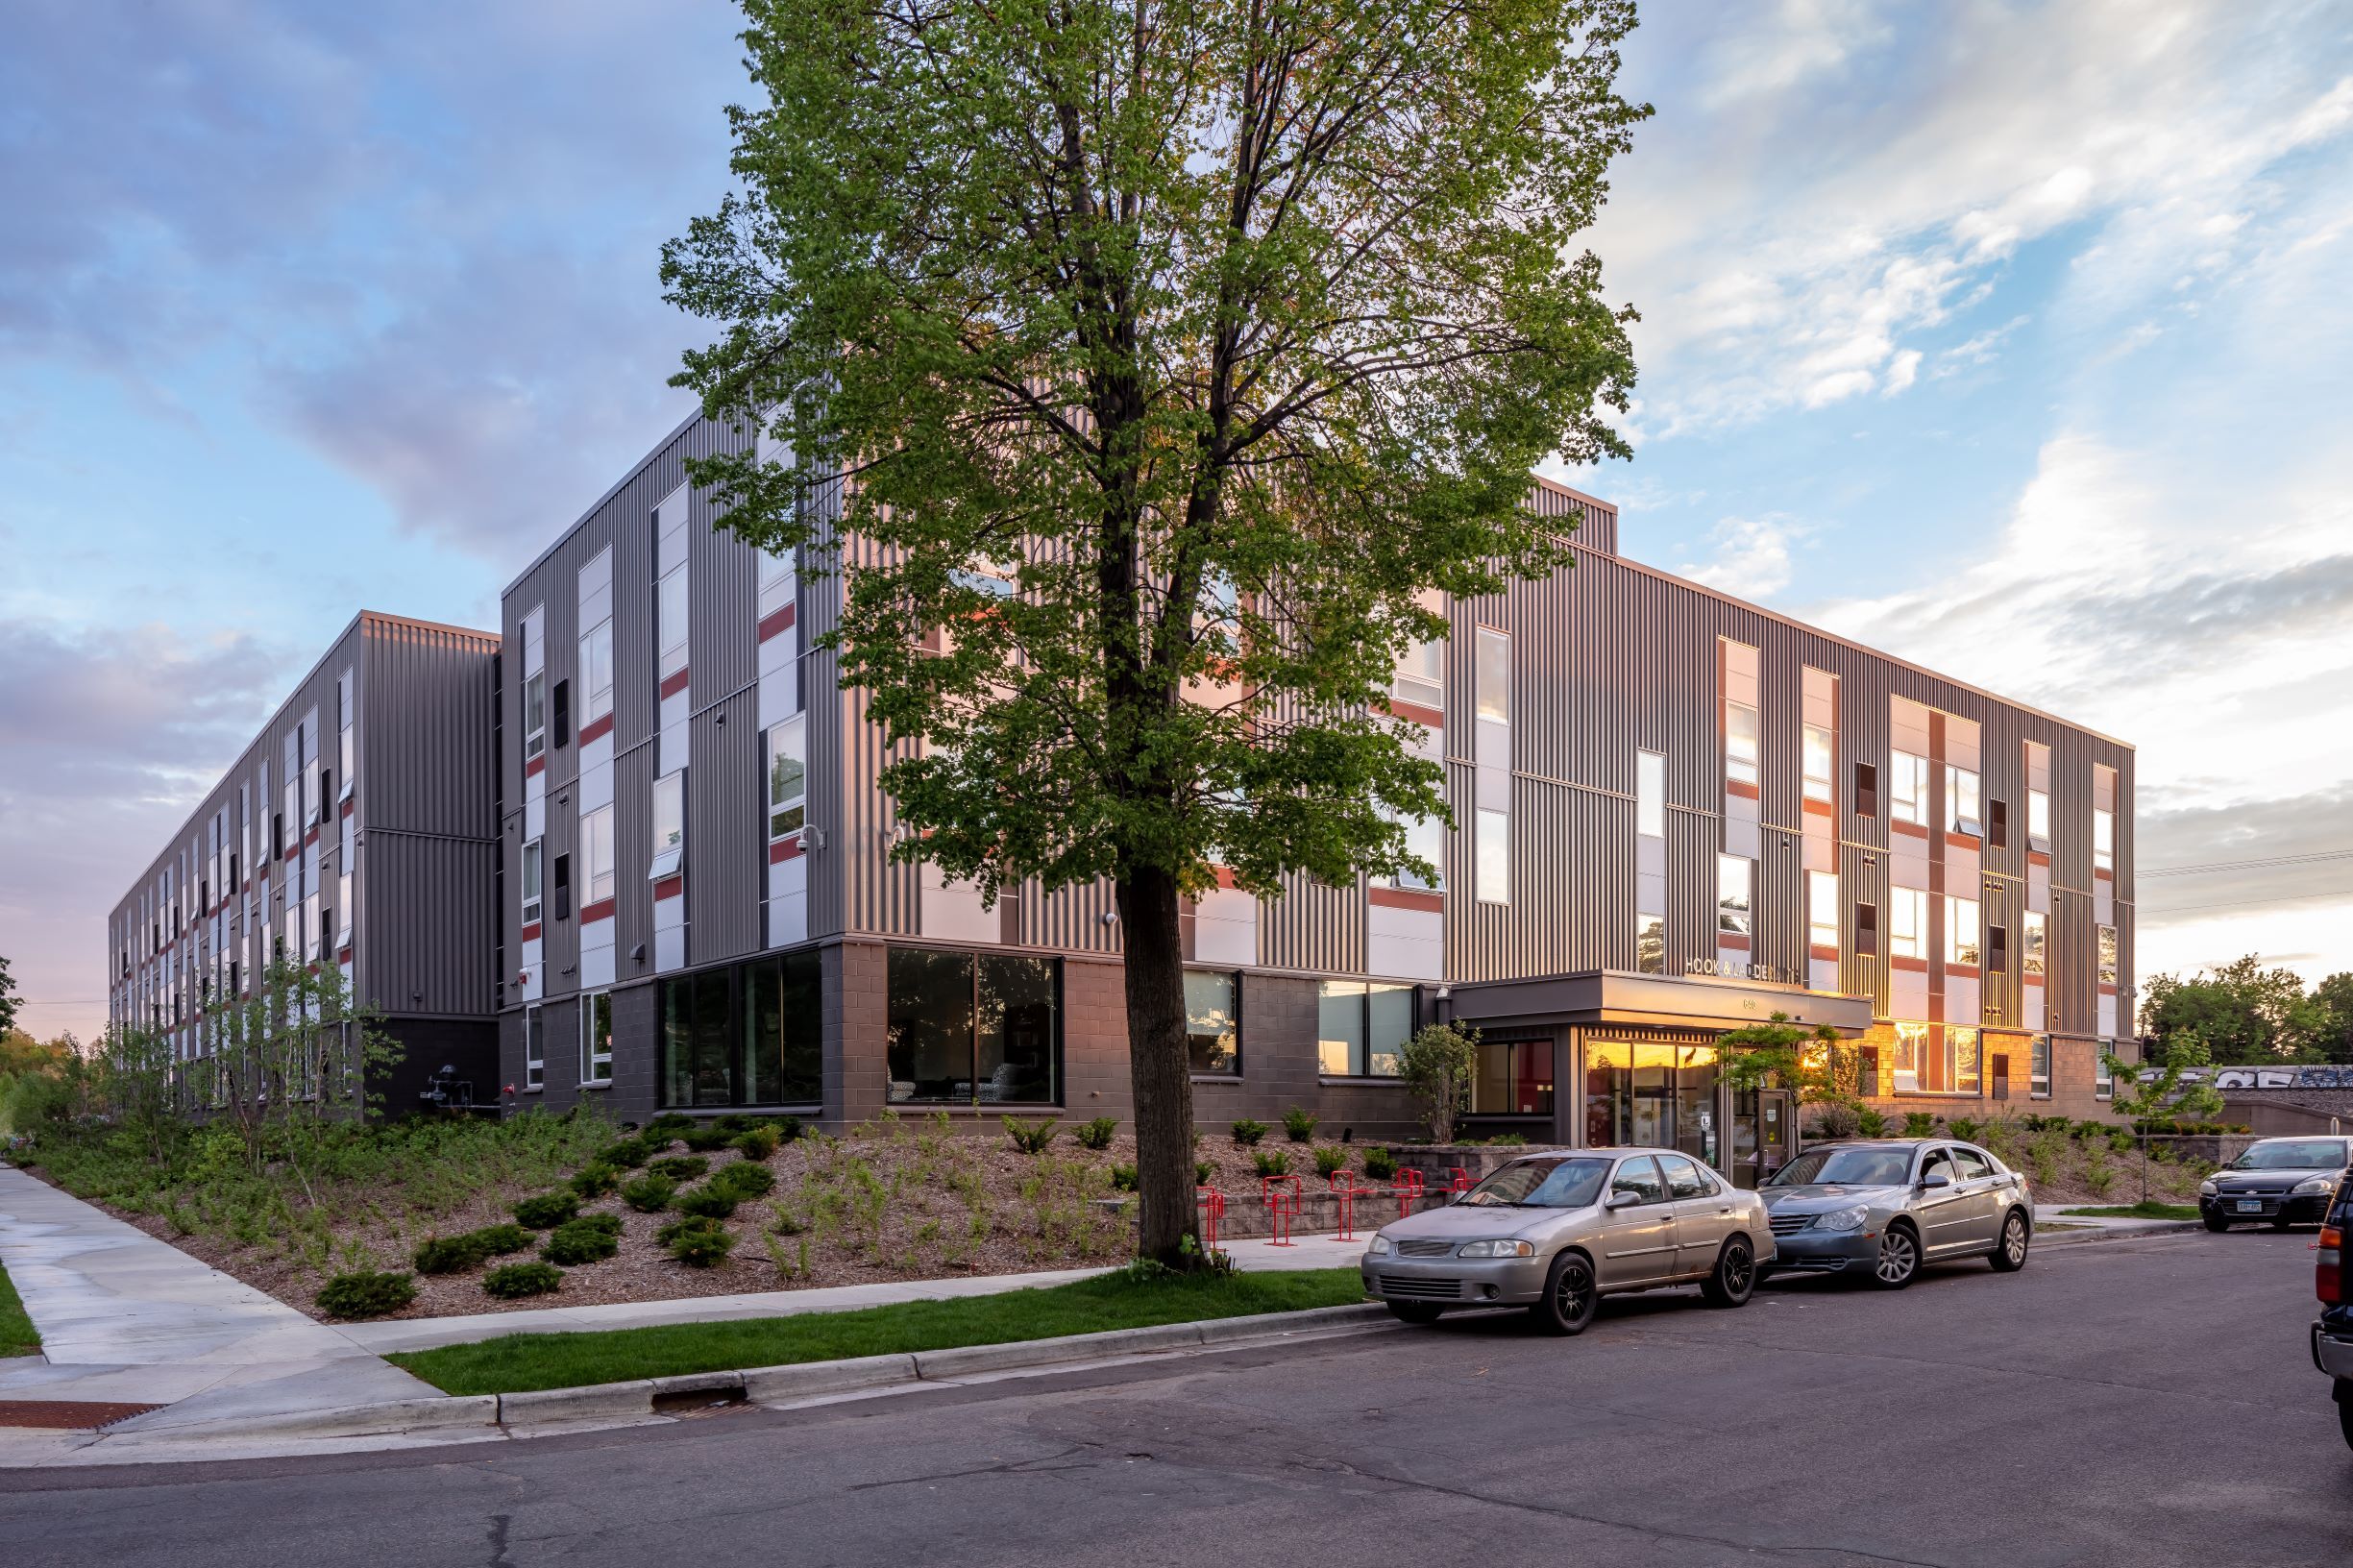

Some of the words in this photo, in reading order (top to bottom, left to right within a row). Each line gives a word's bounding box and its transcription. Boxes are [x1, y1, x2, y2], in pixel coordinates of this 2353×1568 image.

[1686, 957, 1719, 974] HOOK
[1723, 961, 1730, 975] &
[1733, 962, 1773, 980] LADDER
